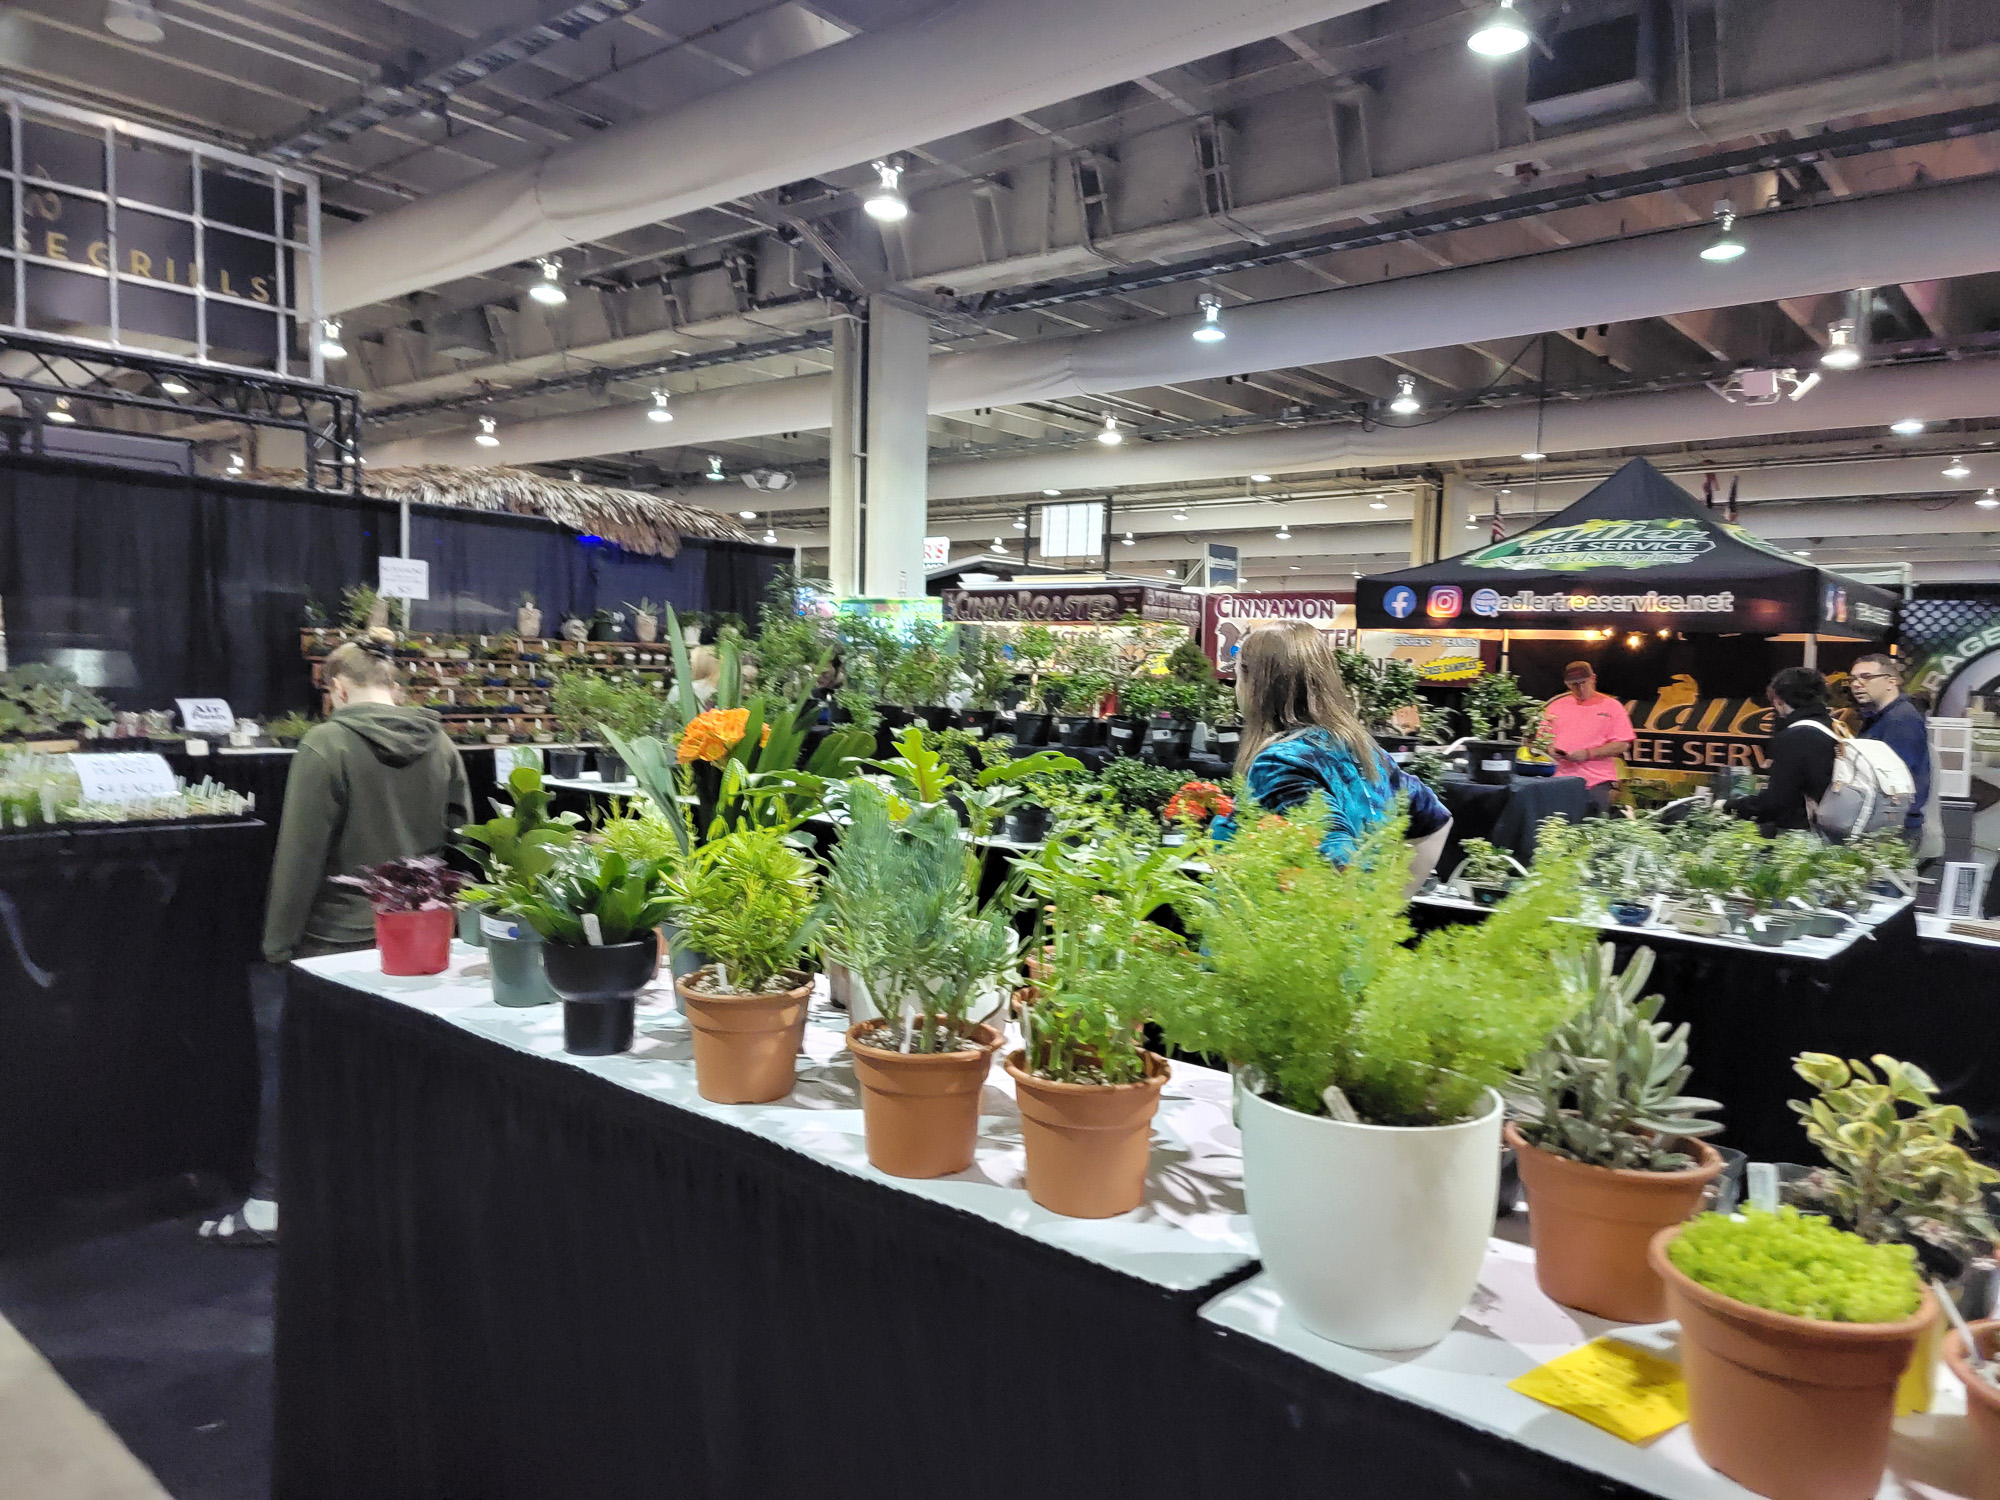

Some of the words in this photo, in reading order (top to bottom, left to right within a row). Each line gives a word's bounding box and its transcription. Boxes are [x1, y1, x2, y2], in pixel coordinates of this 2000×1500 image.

[1523, 543, 1581, 553] TREE
[1586, 540, 1697, 552] SERVICE
[1216, 594, 1334, 619] CINNAMON
[1500, 590, 1735, 612] adlertreeservice.net
